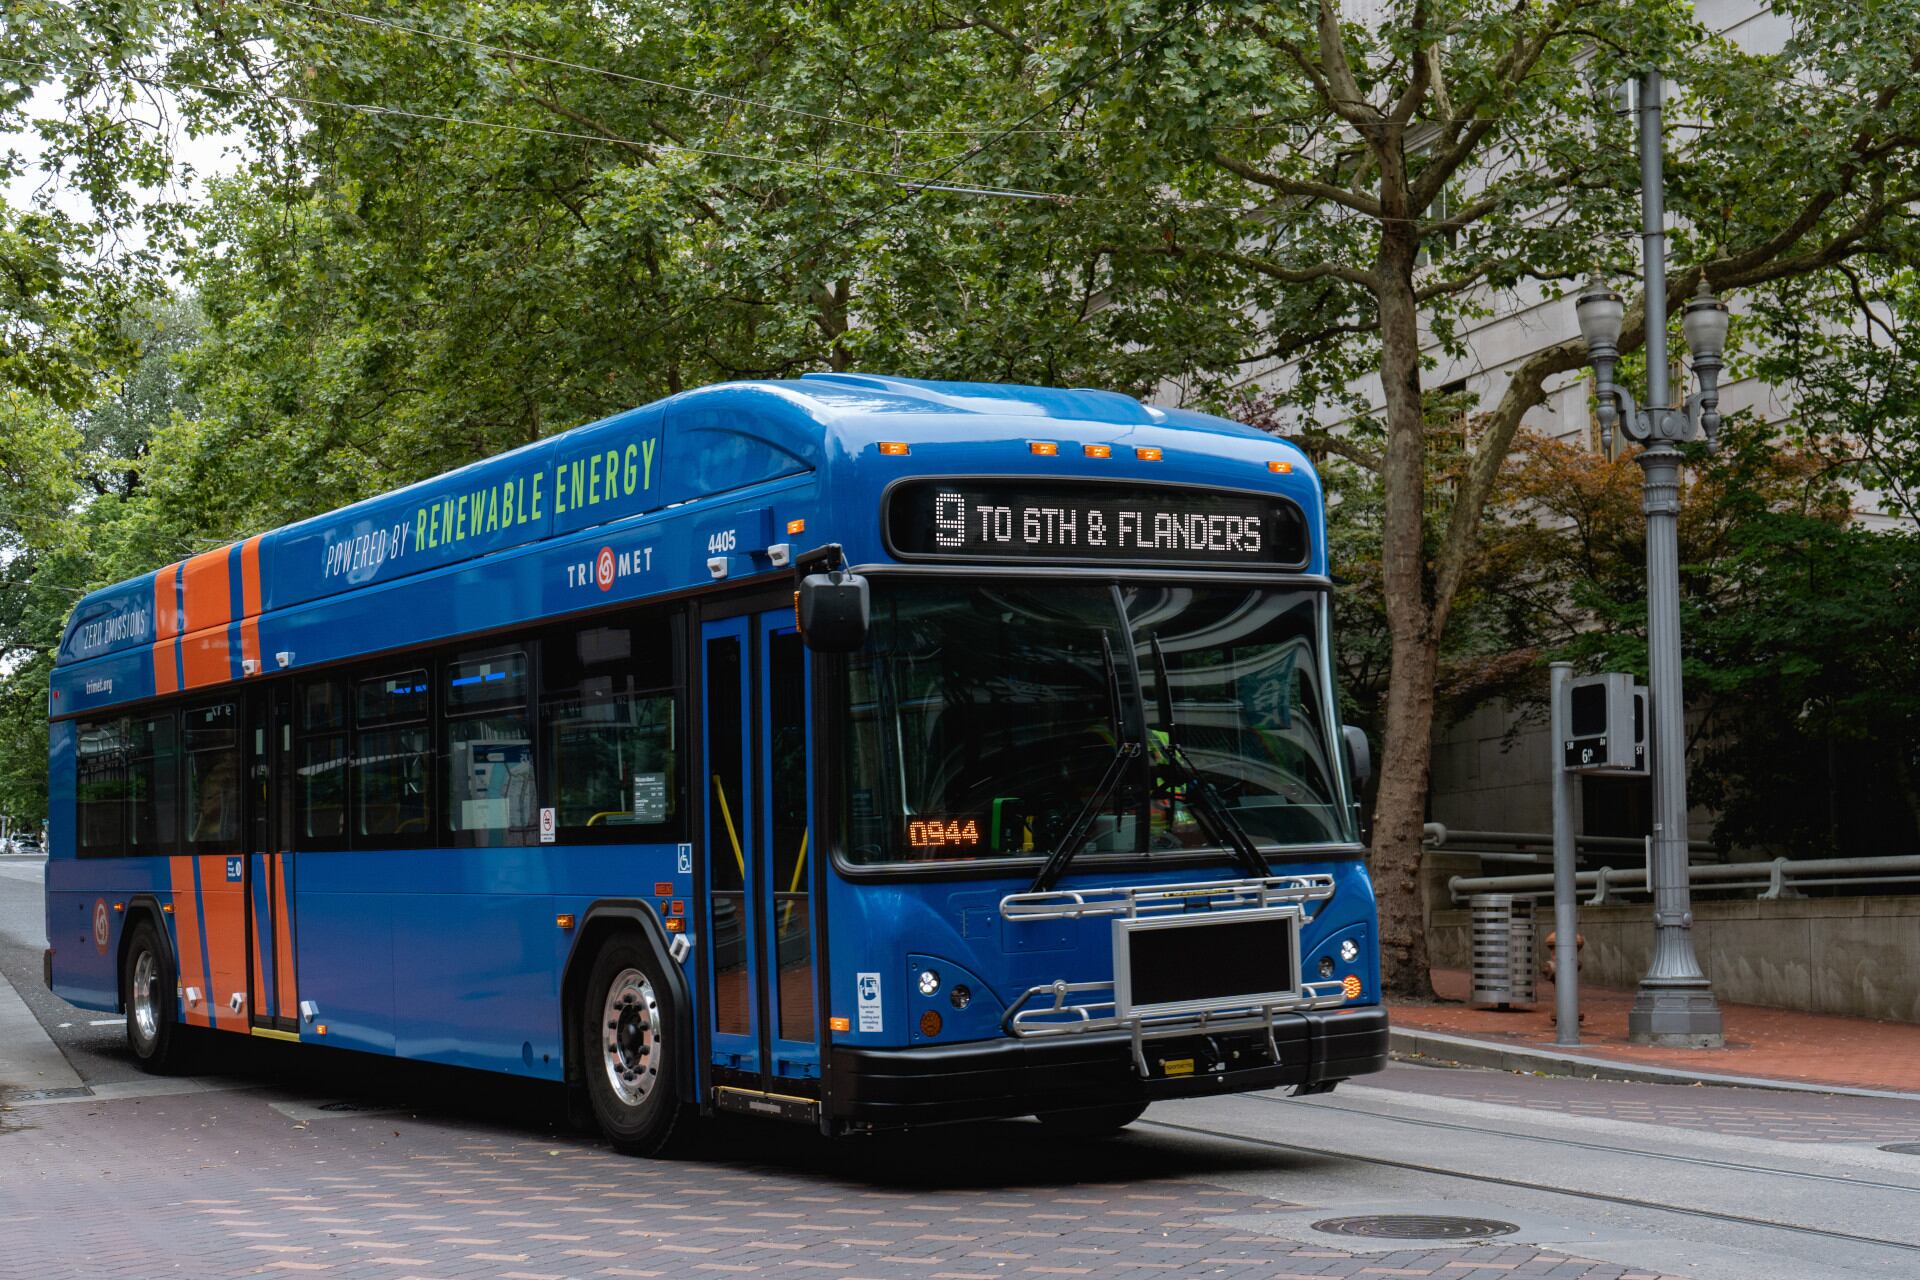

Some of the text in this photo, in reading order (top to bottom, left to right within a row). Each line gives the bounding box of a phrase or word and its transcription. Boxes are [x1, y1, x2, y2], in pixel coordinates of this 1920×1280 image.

[325, 437, 657, 579] POWERED BY RENEWABLE ENERGY
[936, 493, 1261, 552] 9 TO 6TH & FLANDERS
[708, 529, 736, 554] 4405
[84, 609, 145, 650] ZERO EMISSIONS
[86, 679, 113, 695] trimet.org
[1566, 742, 1574, 750] SW
[1581, 748, 1594, 763] 6th
[909, 820, 979, 846] 0944
